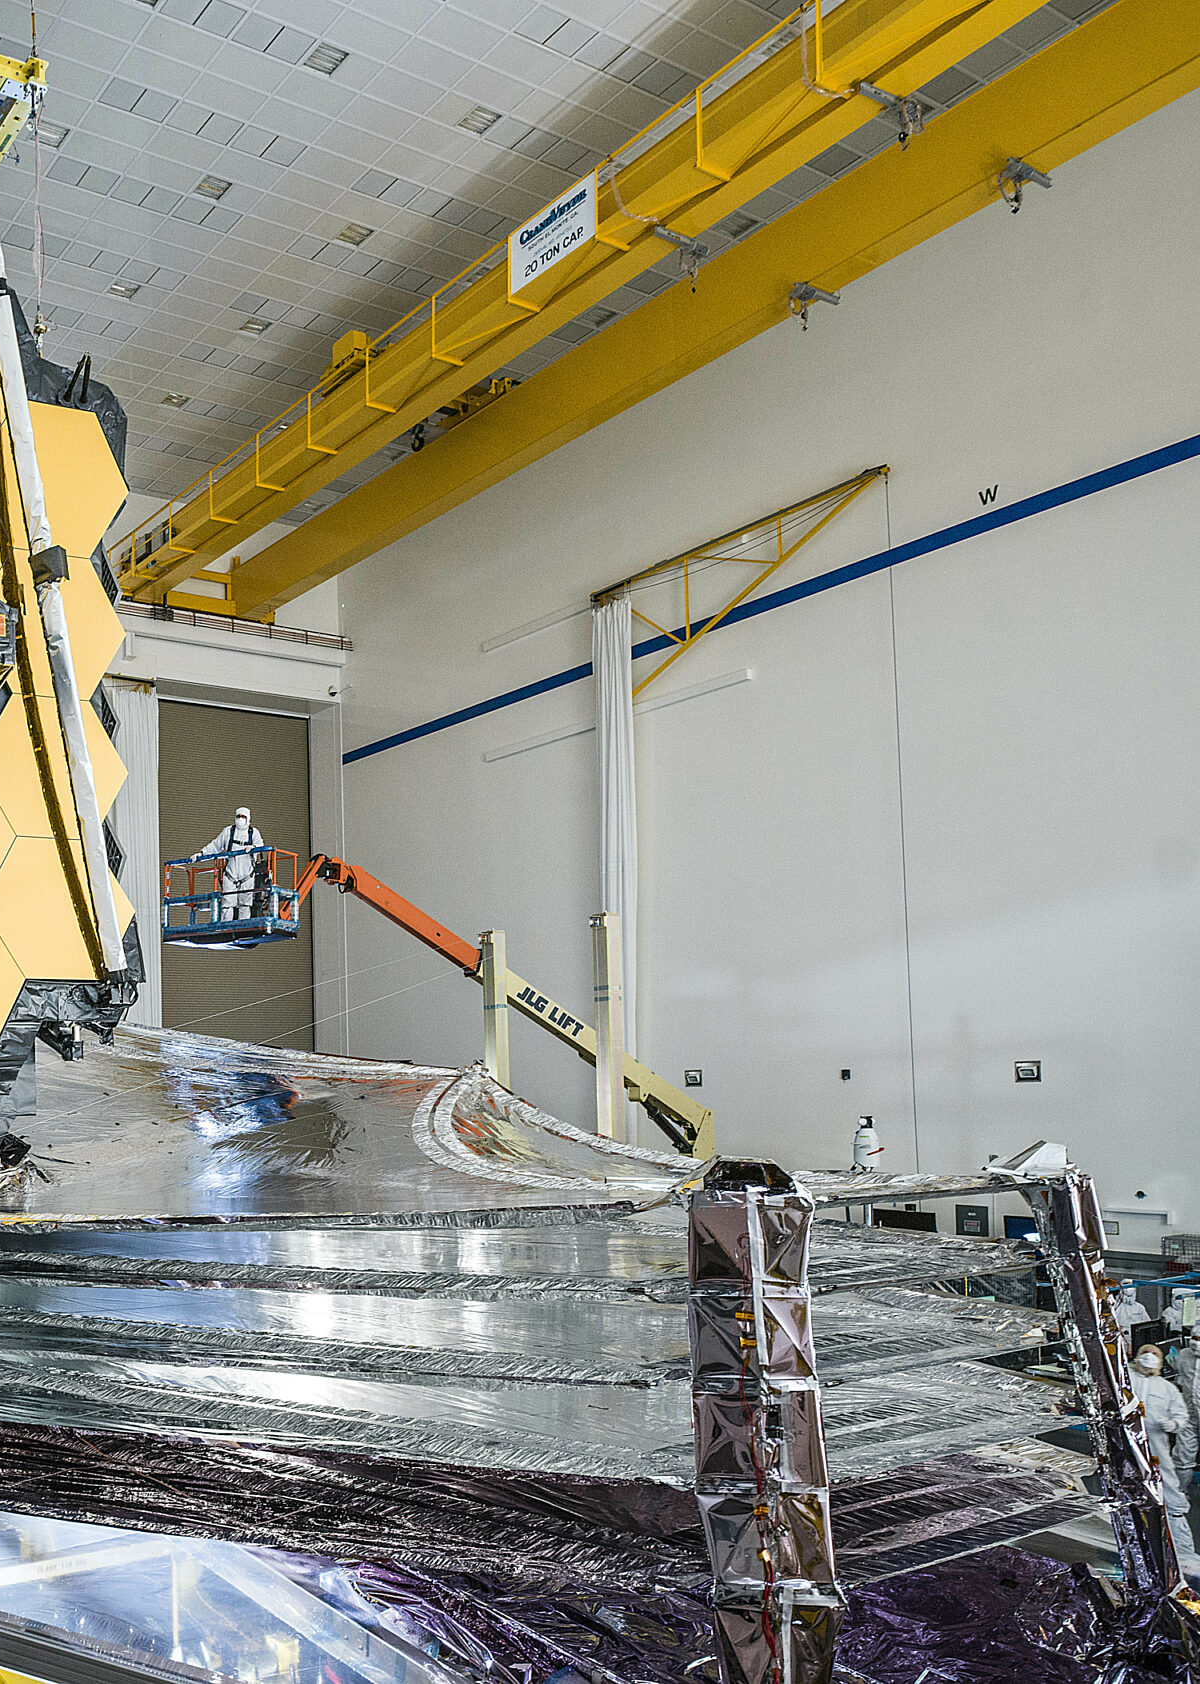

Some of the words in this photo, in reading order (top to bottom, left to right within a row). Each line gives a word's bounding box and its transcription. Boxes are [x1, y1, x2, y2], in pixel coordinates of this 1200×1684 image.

[524, 260, 538, 278] 20
[539, 242, 560, 265] TON
[562, 226, 584, 249] CAP.
[978, 484, 999, 506] W
[516, 986, 549, 1014] JLG
[547, 1005, 585, 1037] LIFT
